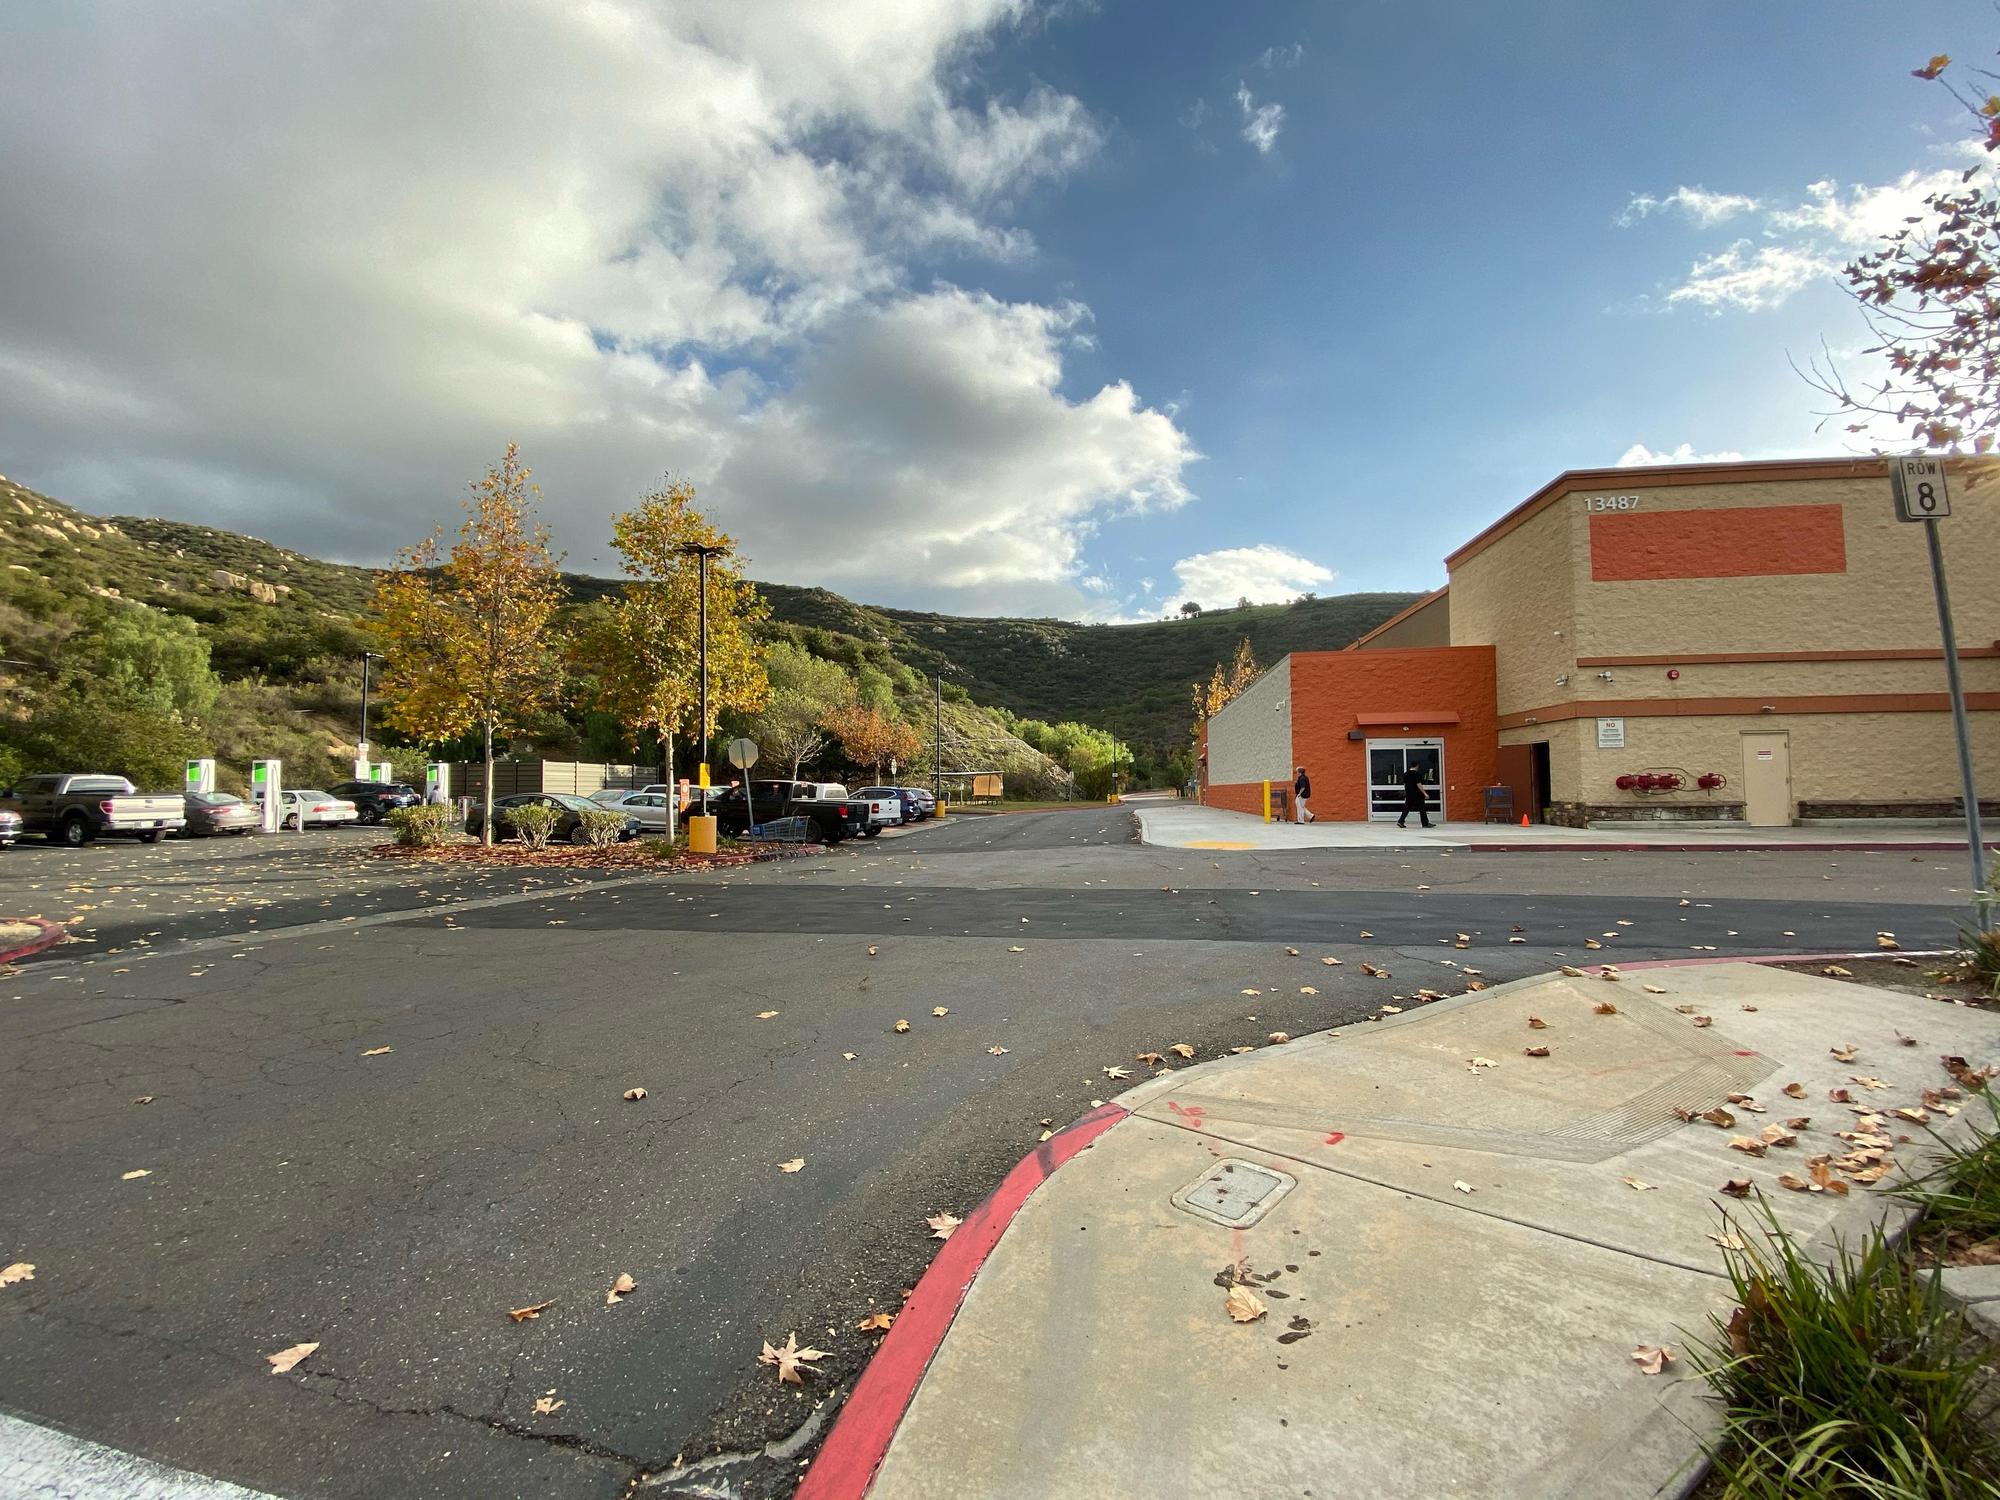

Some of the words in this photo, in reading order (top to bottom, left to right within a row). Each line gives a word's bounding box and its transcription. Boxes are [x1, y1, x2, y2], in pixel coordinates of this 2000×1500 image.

[1907, 462, 1936, 475] ROW
[1584, 495, 1640, 511] 13487
[1918, 482, 1936, 511] 8
